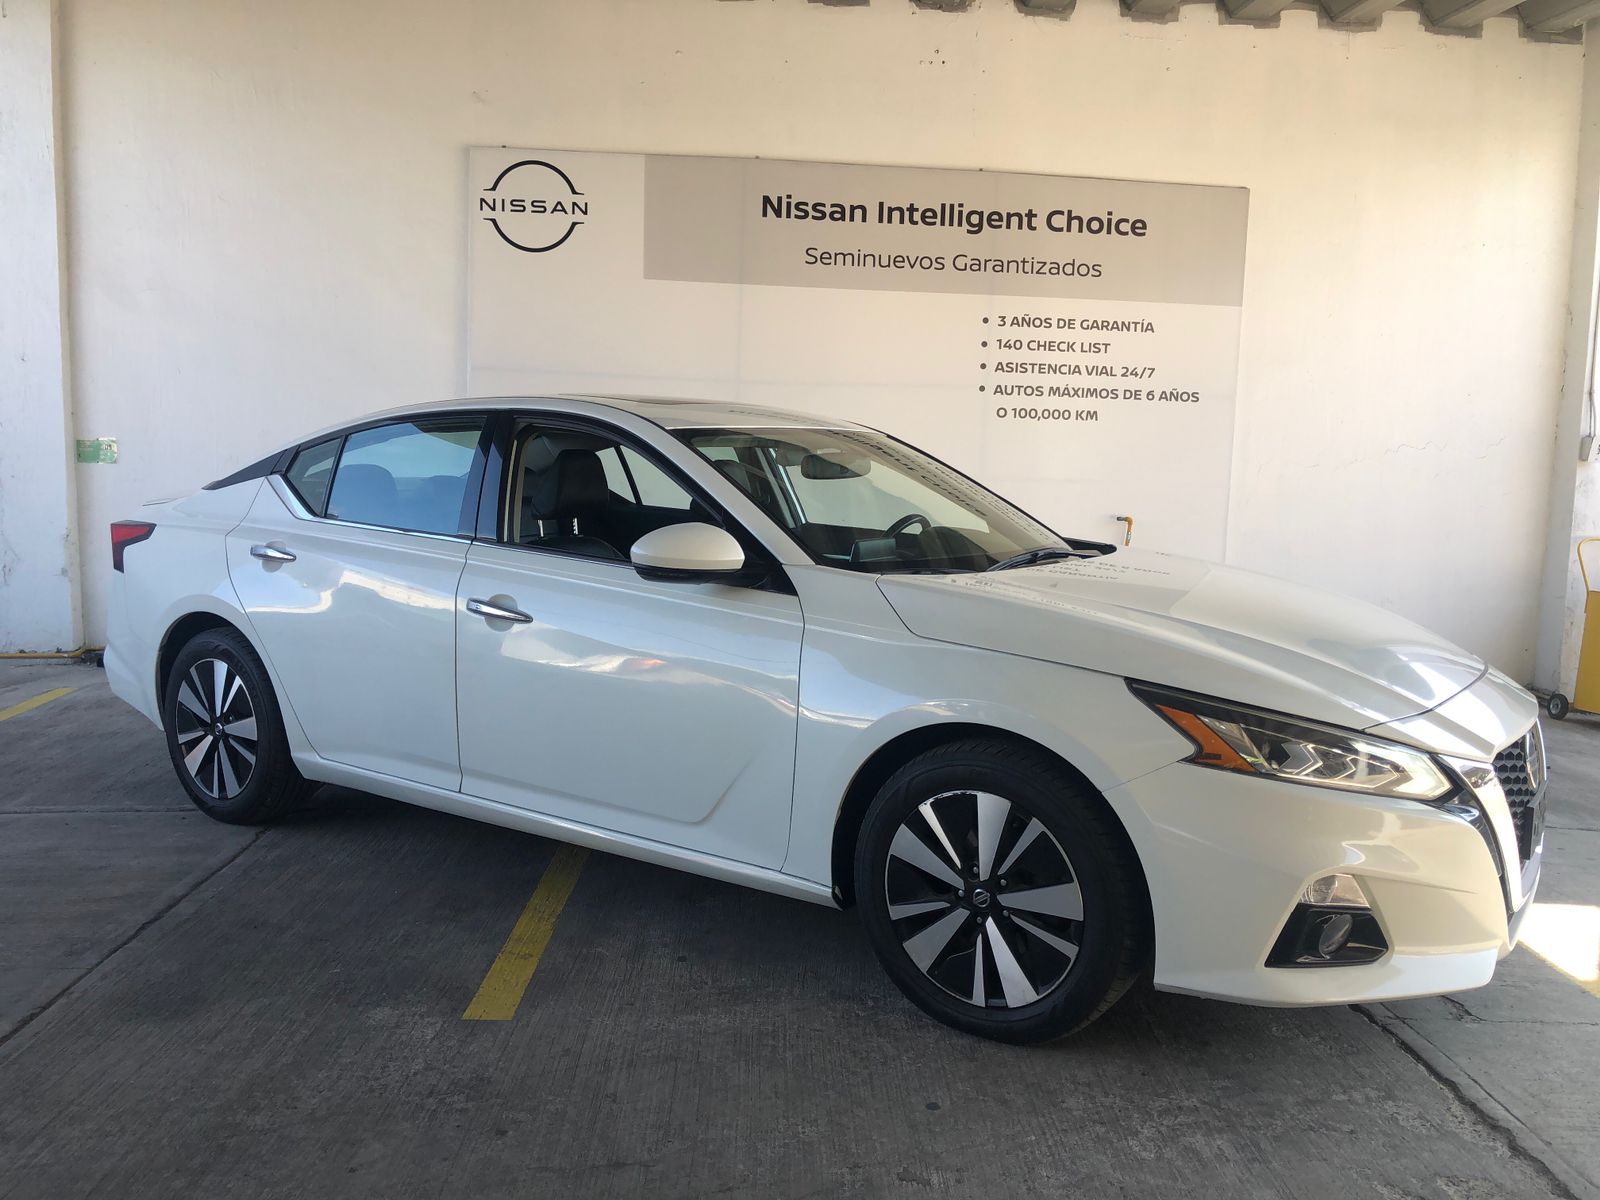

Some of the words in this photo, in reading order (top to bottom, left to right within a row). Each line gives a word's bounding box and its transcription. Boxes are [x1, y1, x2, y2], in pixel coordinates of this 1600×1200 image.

[479, 197, 588, 216] NISSAN
[761, 194, 868, 223] Nissan
[877, 201, 1038, 235] Intelligent
[1045, 209, 1148, 237] Choice
[804, 247, 946, 271] Seminuevos
[952, 253, 1102, 278] Garantizados
[997, 314, 1007, 327] 3
[1009, 313, 1053, 329] AÑOS
[1056, 317, 1077, 330] DE
[1079, 318, 1155, 334] GARANTÍA
[996, 338, 1023, 351] 140
[1026, 339, 1077, 353] CHECK
[1080, 341, 1112, 354] LIST
[994, 361, 1082, 376] ASISTENCIA
[1084, 364, 1118, 377] VIAL
[1120, 366, 1156, 380] 24/7
[993, 384, 1044, 397] AUTOS
[1047, 383, 1119, 400] MÁXIMOS
[1122, 389, 1143, 401] DE
[1145, 389, 1155, 402] 6
[1158, 387, 1200, 403] AÑOS
[996, 407, 1008, 419] O
[1011, 407, 1072, 422] 100,000
[1075, 409, 1099, 422] KM
